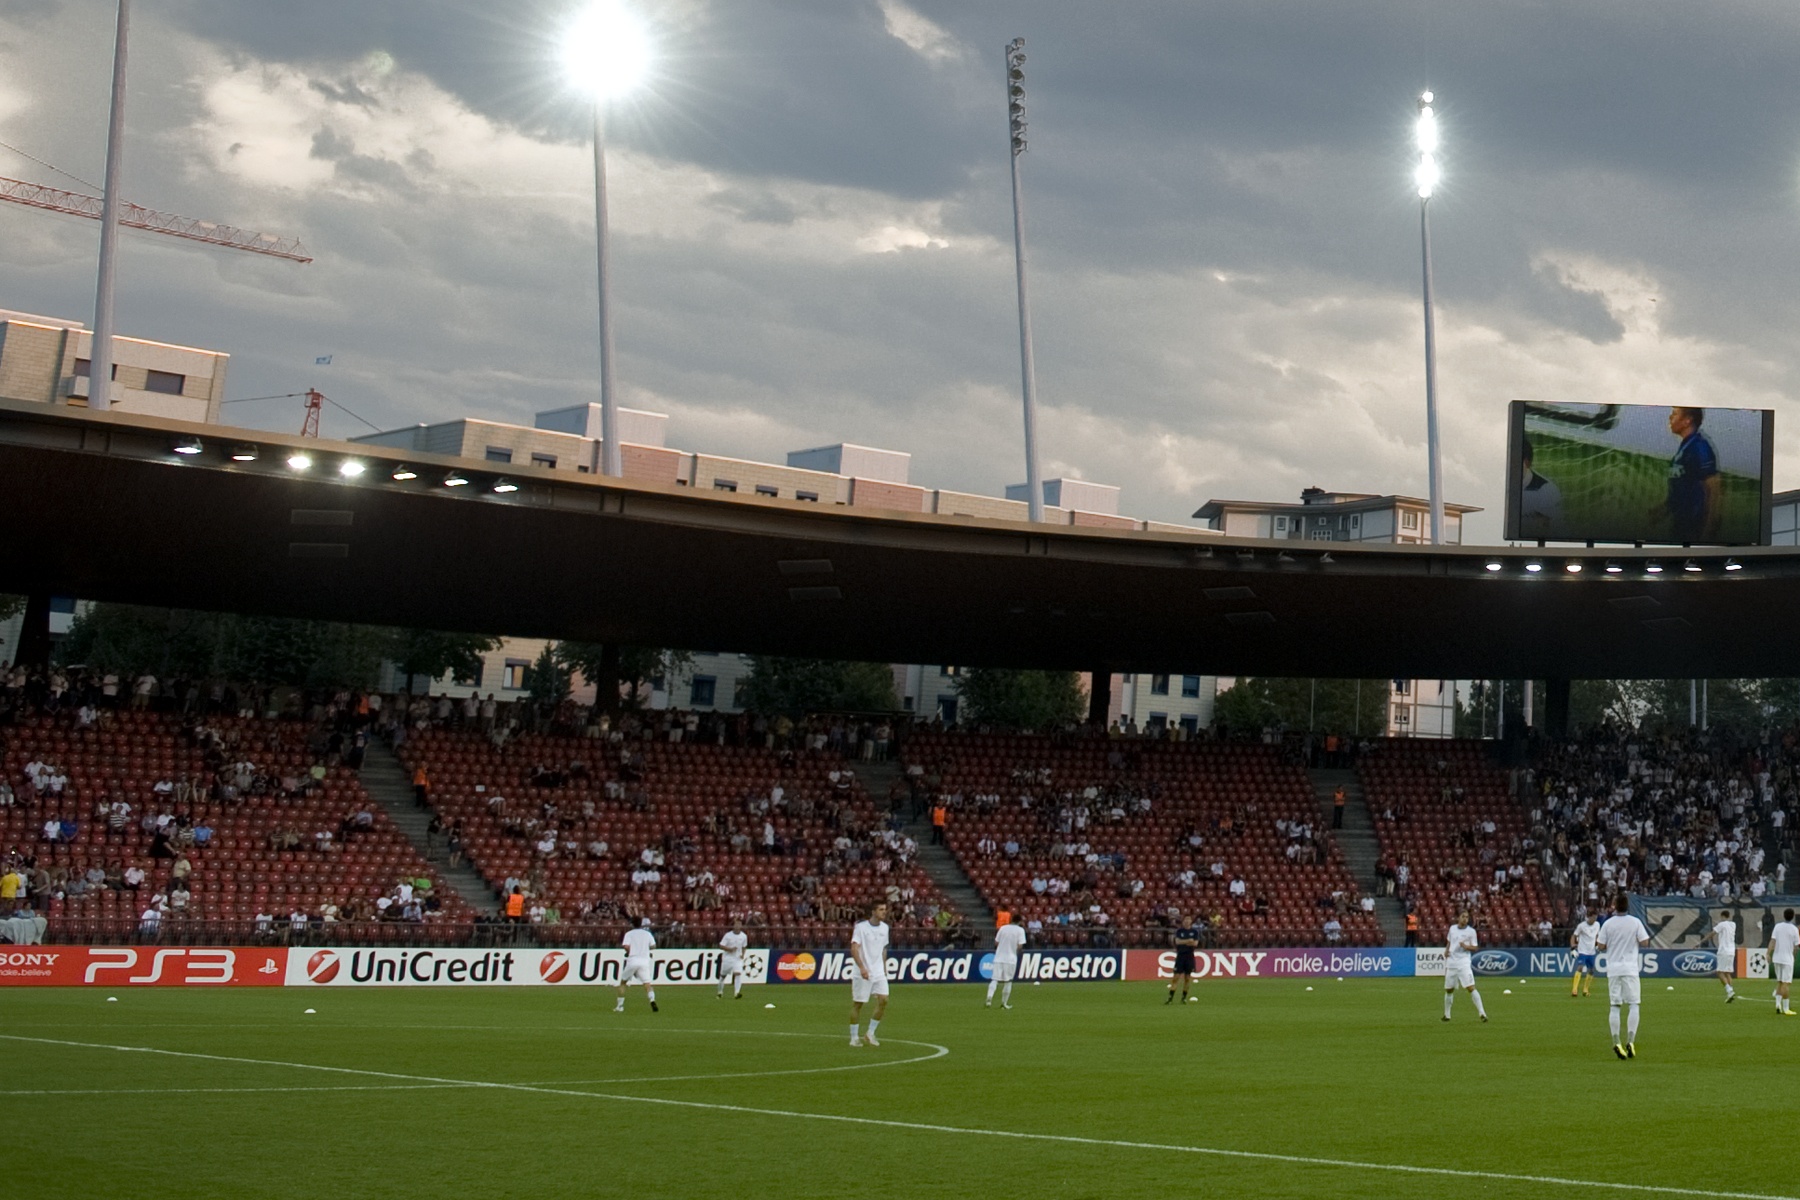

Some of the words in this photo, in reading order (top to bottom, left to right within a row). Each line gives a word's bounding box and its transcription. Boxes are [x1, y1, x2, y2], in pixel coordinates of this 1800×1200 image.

[0, 969, 52, 977] ake.believe
[84, 948, 236, 983] PS3
[350, 951, 514, 982] UniCredit
[579, 952, 724, 981] Unredit
[818, 953, 972, 980] MaerCard
[1018, 953, 1117, 979] Maestro
[1158, 951, 1267, 978] SONY
[1274, 953, 1392, 973] make.believe
[1477, 956, 1509, 971] Ford
[1530, 952, 1576, 973] NEW
[1680, 956, 1713, 972] Ford
